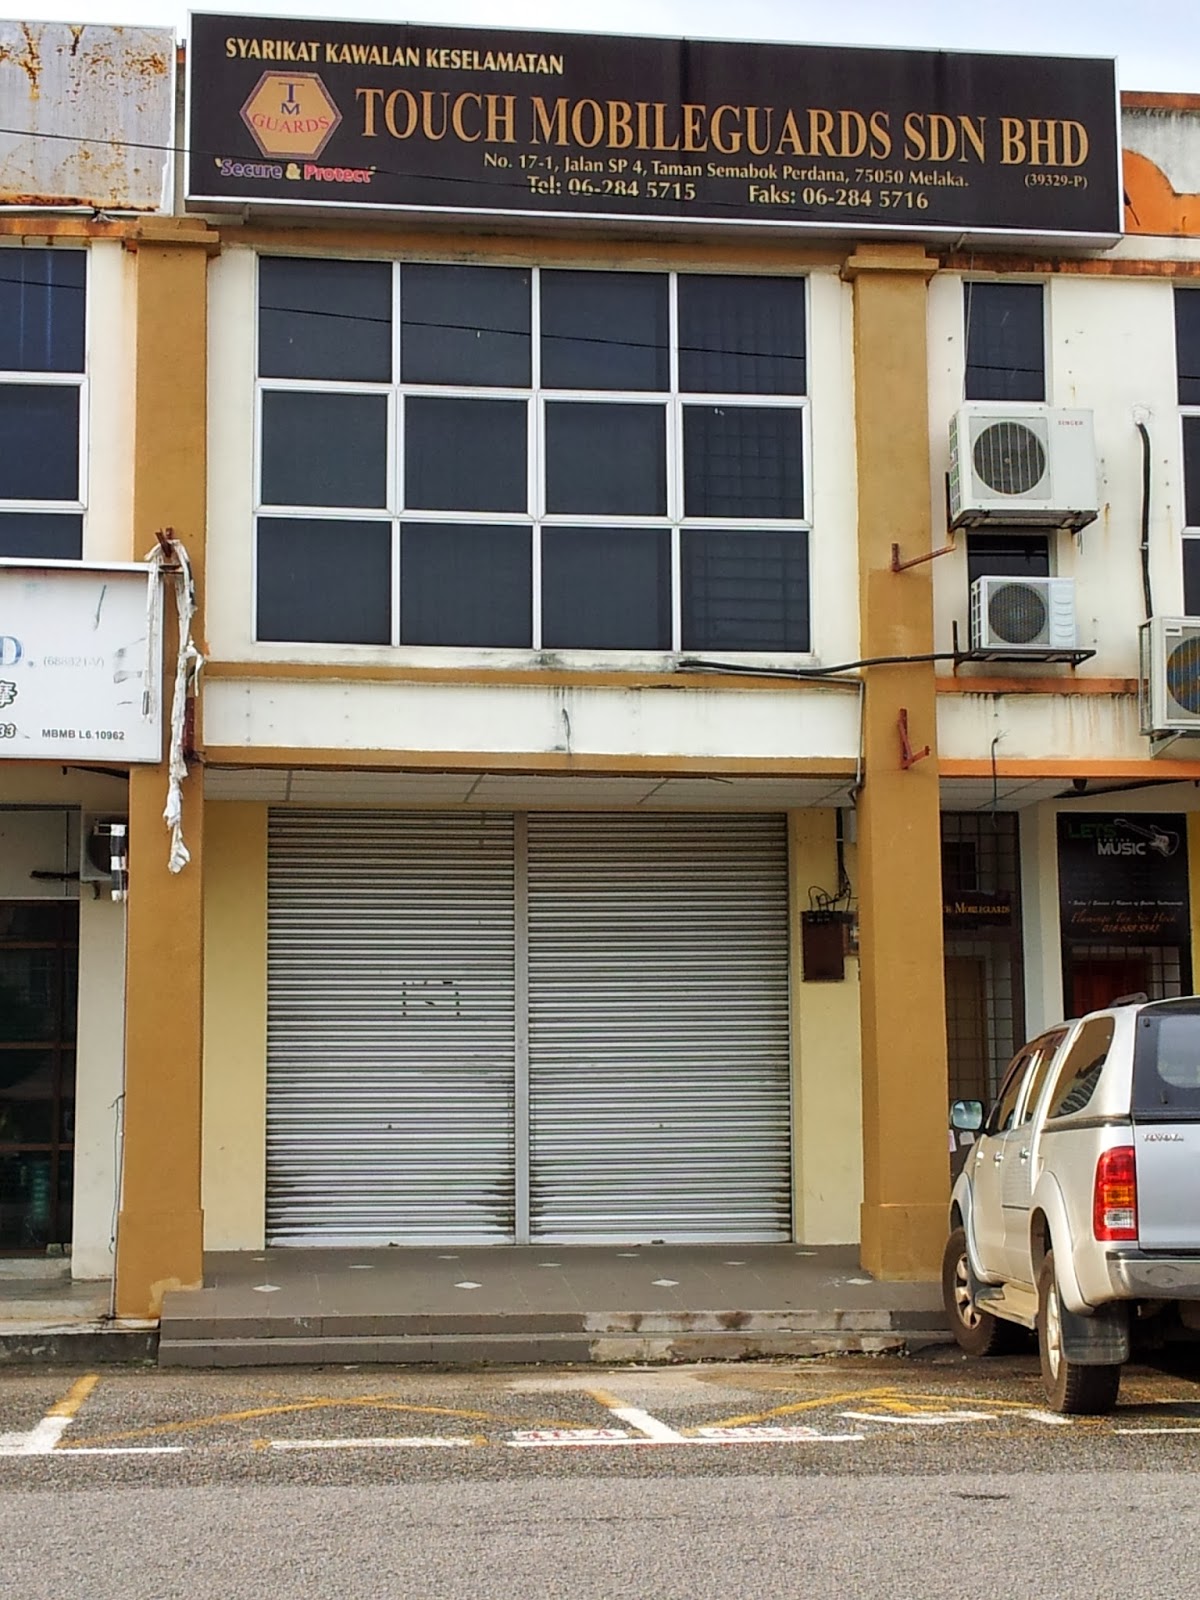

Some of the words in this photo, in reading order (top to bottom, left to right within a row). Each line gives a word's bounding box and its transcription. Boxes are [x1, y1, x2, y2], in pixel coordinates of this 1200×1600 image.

[226, 37, 320, 62] SYARIKAT
[326, 43, 420, 67] KAWALAN
[426, 48, 564, 75] KESELAMATAN
[278, 82, 305, 103] T
[281, 103, 300, 115] M
[252, 113, 330, 134] GUARDS
[355, 87, 517, 145] TOUCH
[529, 96, 892, 160] MOBILEGUARDS
[904, 112, 987, 164] SDN
[999, 117, 1089, 168] BHD
[285, 163, 301, 180] &
[484, 153, 513, 168] No.
[519, 155, 559, 173] 17-1,
[564, 156, 603, 173] Jalan
[608, 158, 628, 173] SP
[632, 160, 647, 177] 4,
[651, 160, 702, 177] Taman
[707, 162, 778, 180] Semabok
[783, 167, 850, 184] Perdana,
[854, 168, 904, 184] 75050
[908, 171, 969, 187] Melaka.
[527, 175, 562, 195] Tel:
[567, 177, 639, 198] 06-284
[646, 181, 696, 200] 5715
[1025, 172, 1088, 190] (39329-P)
[749, 185, 796, 204] Faks:
[803, 187, 872, 207] 06-284
[879, 191, 929, 209] 5716
[42, 729, 76, 739] MBMB
[1097, 842, 1146, 855] MUSIC
